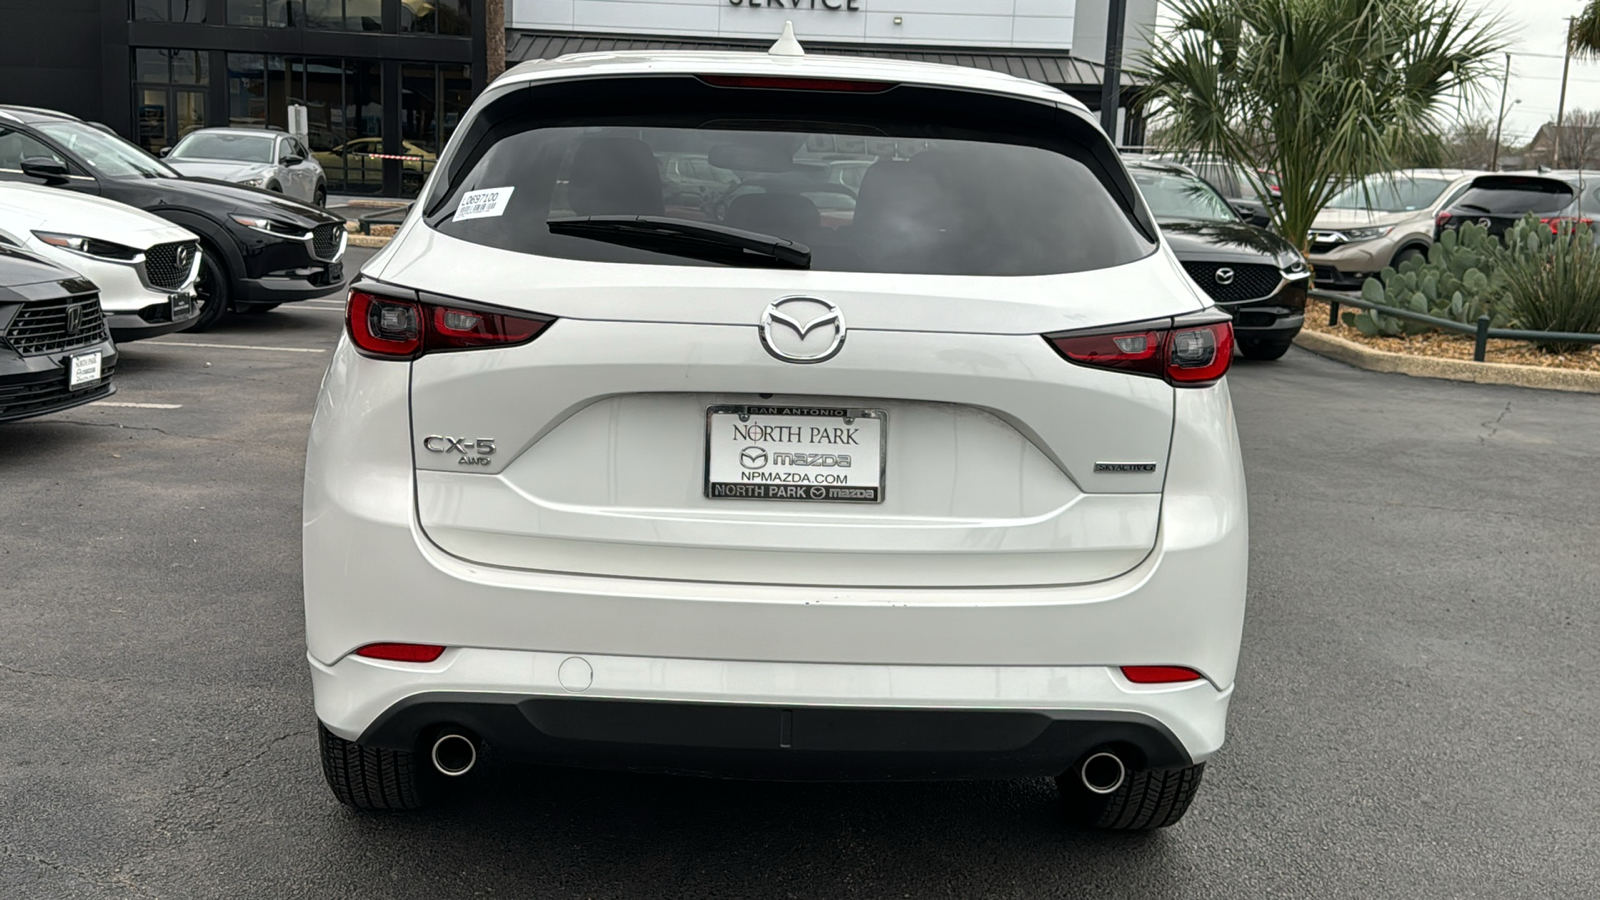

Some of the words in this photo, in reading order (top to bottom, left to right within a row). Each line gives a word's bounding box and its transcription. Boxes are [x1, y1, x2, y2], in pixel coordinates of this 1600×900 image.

[782, 408, 843, 416] ANTONIO
[732, 423, 803, 443] NORTH
[809, 427, 860, 445] PARK
[423, 434, 496, 455] CX-5
[458, 456, 491, 466] AWD
[773, 452, 851, 467] mazda
[741, 472, 848, 484] NPMAZDA.COM
[715, 485, 764, 497] NORTH
[769, 486, 806, 498] PARK
[829, 488, 874, 499] mazda
